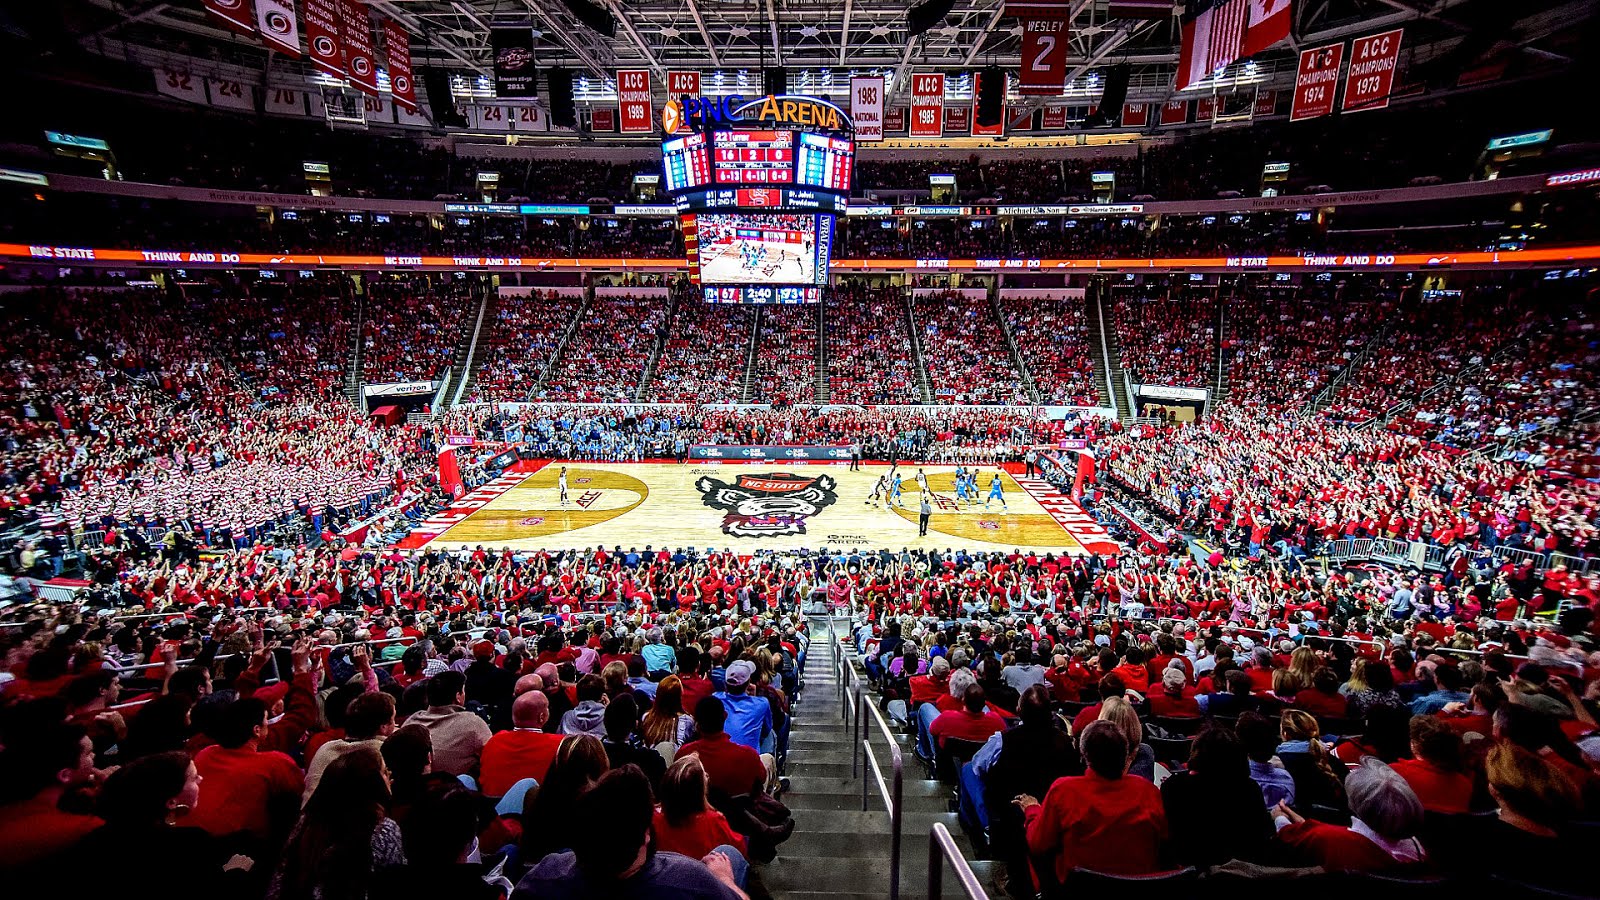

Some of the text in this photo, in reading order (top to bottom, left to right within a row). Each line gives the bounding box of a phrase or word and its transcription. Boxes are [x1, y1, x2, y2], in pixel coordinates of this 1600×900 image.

[308, 2, 334, 22] DIVISION
[306, 12, 338, 35] CHAMPIONS
[1028, 20, 1065, 33] WESLEY
[1032, 36, 1056, 72] 2
[1361, 37, 1390, 59] ACC
[1351, 56, 1394, 77] CHAMPIONS
[166, 70, 193, 91] 32
[625, 73, 643, 89] ACC
[675, 74, 694, 90] ACC
[1298, 68, 1337, 87] CHAMPIONS
[219, 79, 242, 98] 24
[918, 77, 938, 93] ACC
[1356, 76, 1380, 95] 1973
[620, 91, 649, 103] CHAMPIONS
[857, 87, 877, 105] 1983
[912, 95, 942, 107] CHAMPIONS
[1304, 86, 1325, 104] 1974
[484, 106, 501, 121] 24
[521, 107, 538, 122] 20
[627, 104, 645, 119] 1989
[684, 94, 840, 129] PNC ARENA
[854, 112, 879, 122] NATIONAL
[918, 110, 936, 124] 1985
[686, 133, 703, 146] NCSU
[716, 132, 727, 142] 22
[832, 139, 850, 152] NCSU
[721, 149, 735, 161] 16
[749, 149, 757, 161] 2
[775, 149, 783, 161] 0
[720, 170, 740, 181] 6-13
[746, 170, 766, 181] 4-10
[209, 192, 235, 201] Home
[238, 193, 247, 201] of
[264, 196, 276, 204] NC
[300, 198, 336, 207] Wolfpack
[717, 198, 730, 206] 2ND
[1252, 199, 1275, 207] Home
[1286, 197, 1300, 206] the
[1316, 195, 1337, 203] State
[1340, 193, 1380, 203] Wolfpack
[626, 206, 671, 214] rexhealth.com
[1003, 207, 1032, 215] Michael
[29, 246, 95, 259] NC STATE
[142, 251, 240, 263] THINK AND DO
[385, 256, 422, 265] NC STATE
[453, 257, 521, 266] THINK AND DO
[819, 246, 828, 282] NEWS
[916, 259, 949, 267] NC STATE
[976, 259, 1040, 267] THINK AND DO
[1227, 257, 1268, 266] NC STATE
[1304, 255, 1395, 266] THINK AND DO
[721, 288, 735, 299] 67
[747, 288, 771, 299] 2:40
[807, 288, 817, 299] 67
[396, 384, 427, 392] verizon
[450, 471, 534, 508] STATE
[744, 480, 803, 490] NC STATE
[576, 490, 600, 508] ACC
